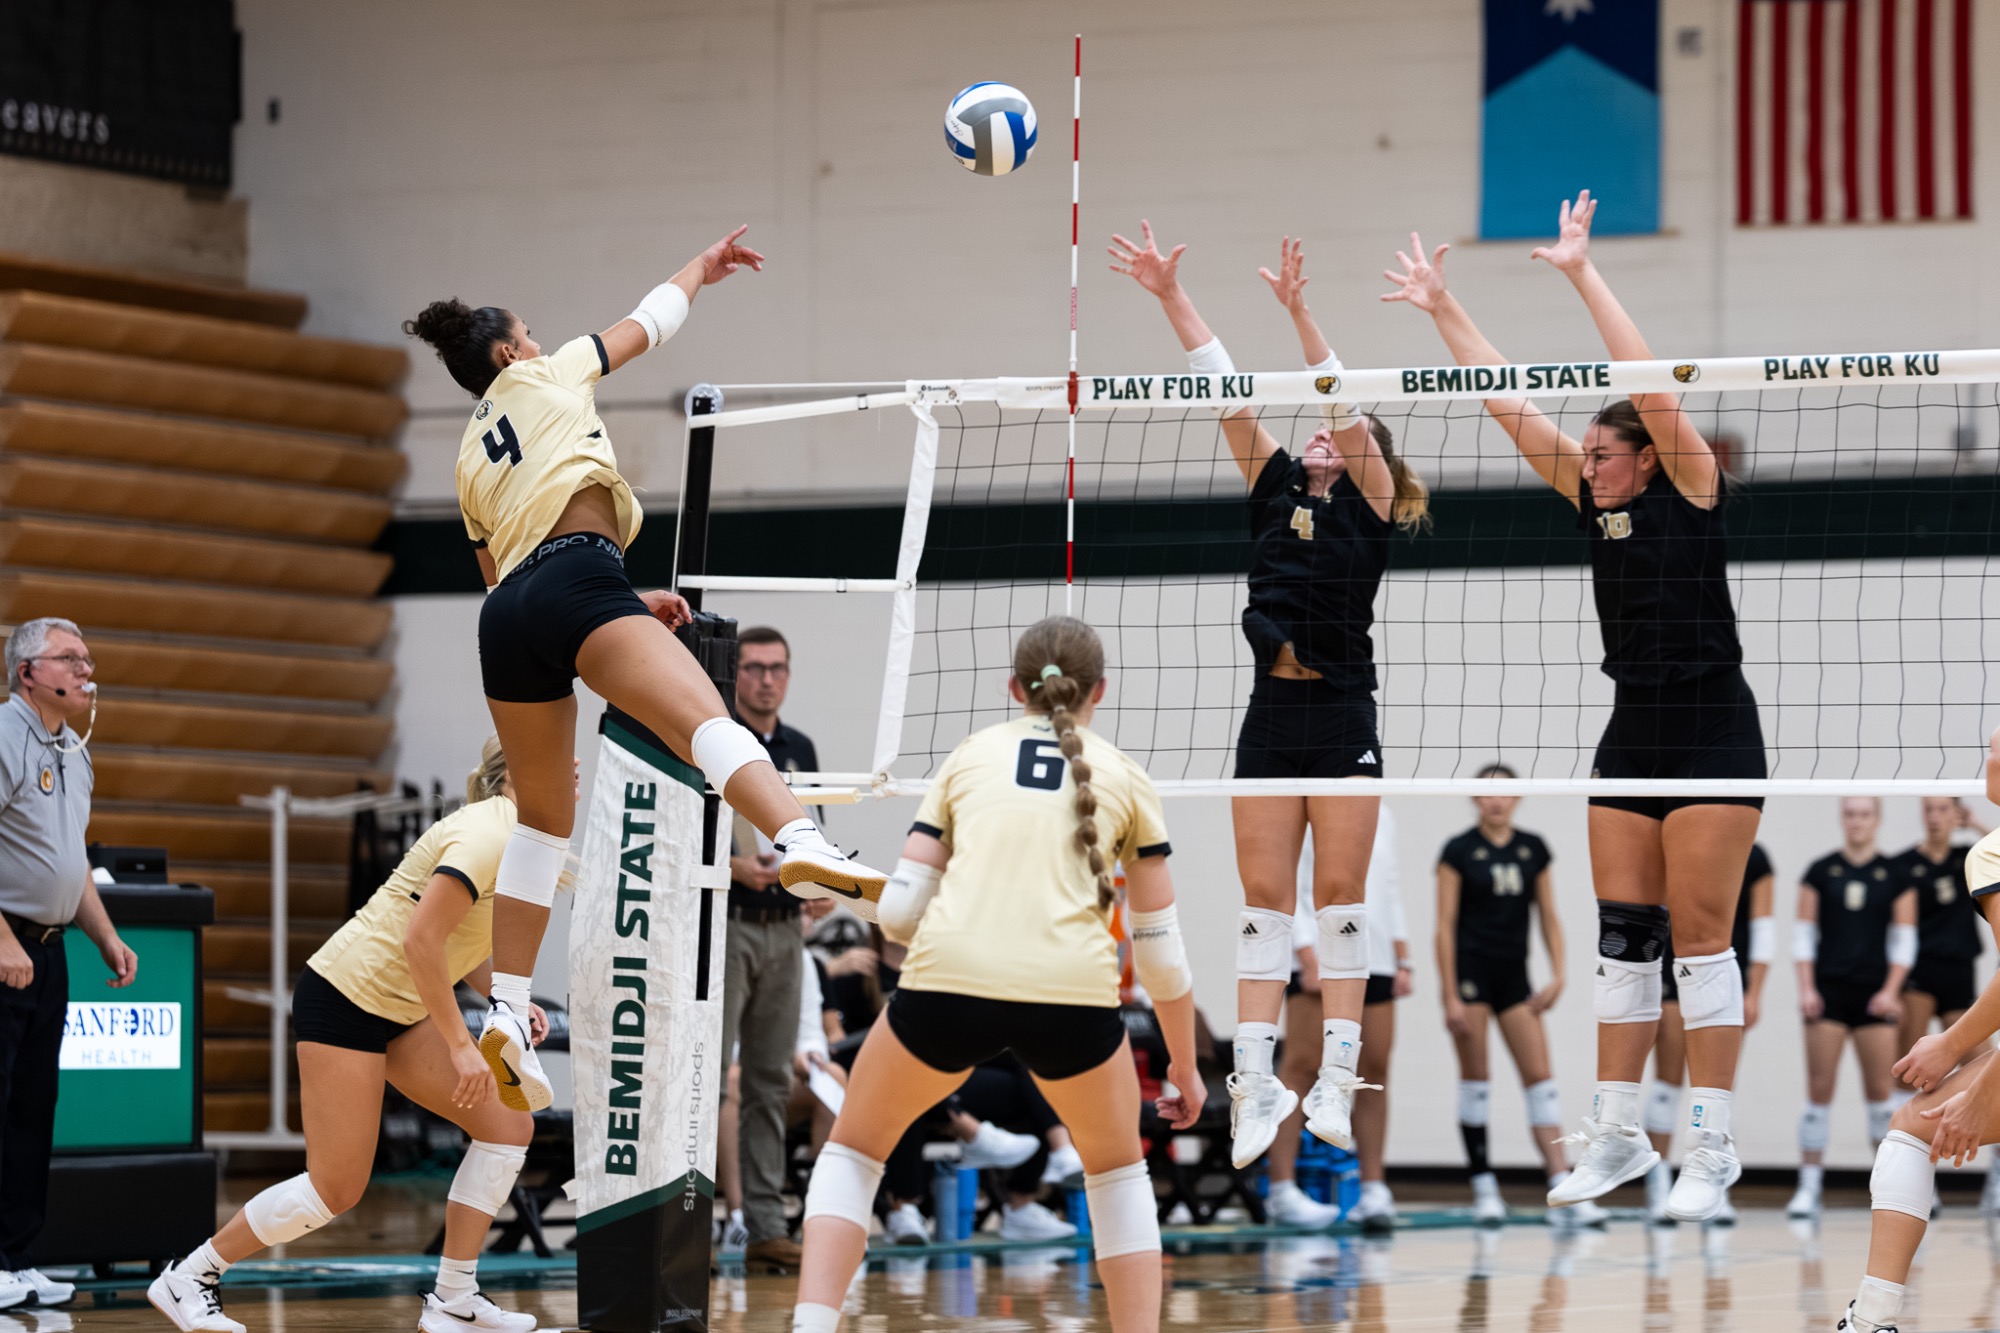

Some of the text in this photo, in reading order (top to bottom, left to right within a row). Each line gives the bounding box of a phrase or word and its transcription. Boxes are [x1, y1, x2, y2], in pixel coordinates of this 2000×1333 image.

[1402, 364, 1611, 393] BEMIDJI STATE
[1762, 353, 1940, 381] PLAY FOR KU
[1093, 375, 1254, 400] PLAY FOR KU
[480, 412, 524, 469] 4
[1290, 506, 1314, 540] 4
[537, 534, 625, 569] PRO NIK
[1015, 737, 1066, 791] 6
[605, 782, 657, 1176] BEMIDJI STATE
[81, 1049, 152, 1065] HEALTH
[683, 1041, 704, 1212] sports imports
